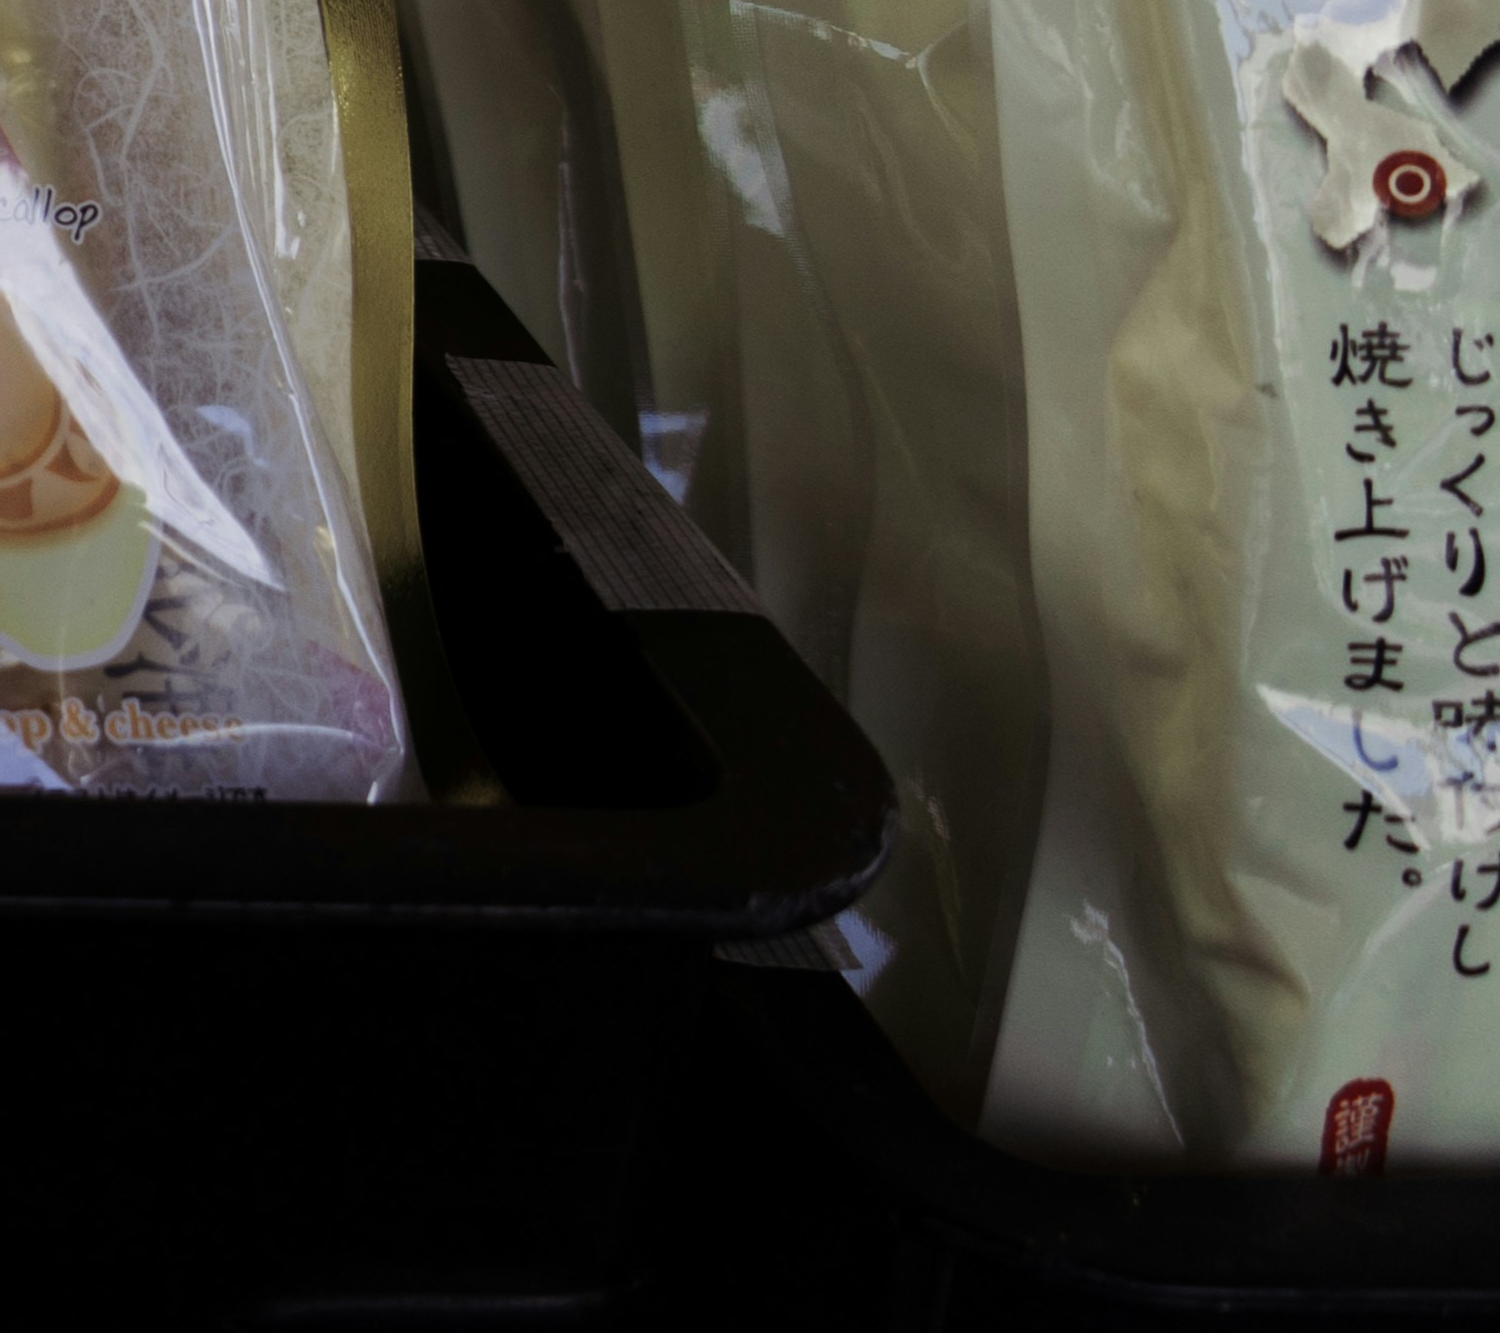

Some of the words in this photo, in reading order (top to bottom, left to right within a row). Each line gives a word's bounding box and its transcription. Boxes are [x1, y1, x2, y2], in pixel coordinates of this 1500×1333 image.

[1328, 321, 1426, 889] 焼き上げました。
